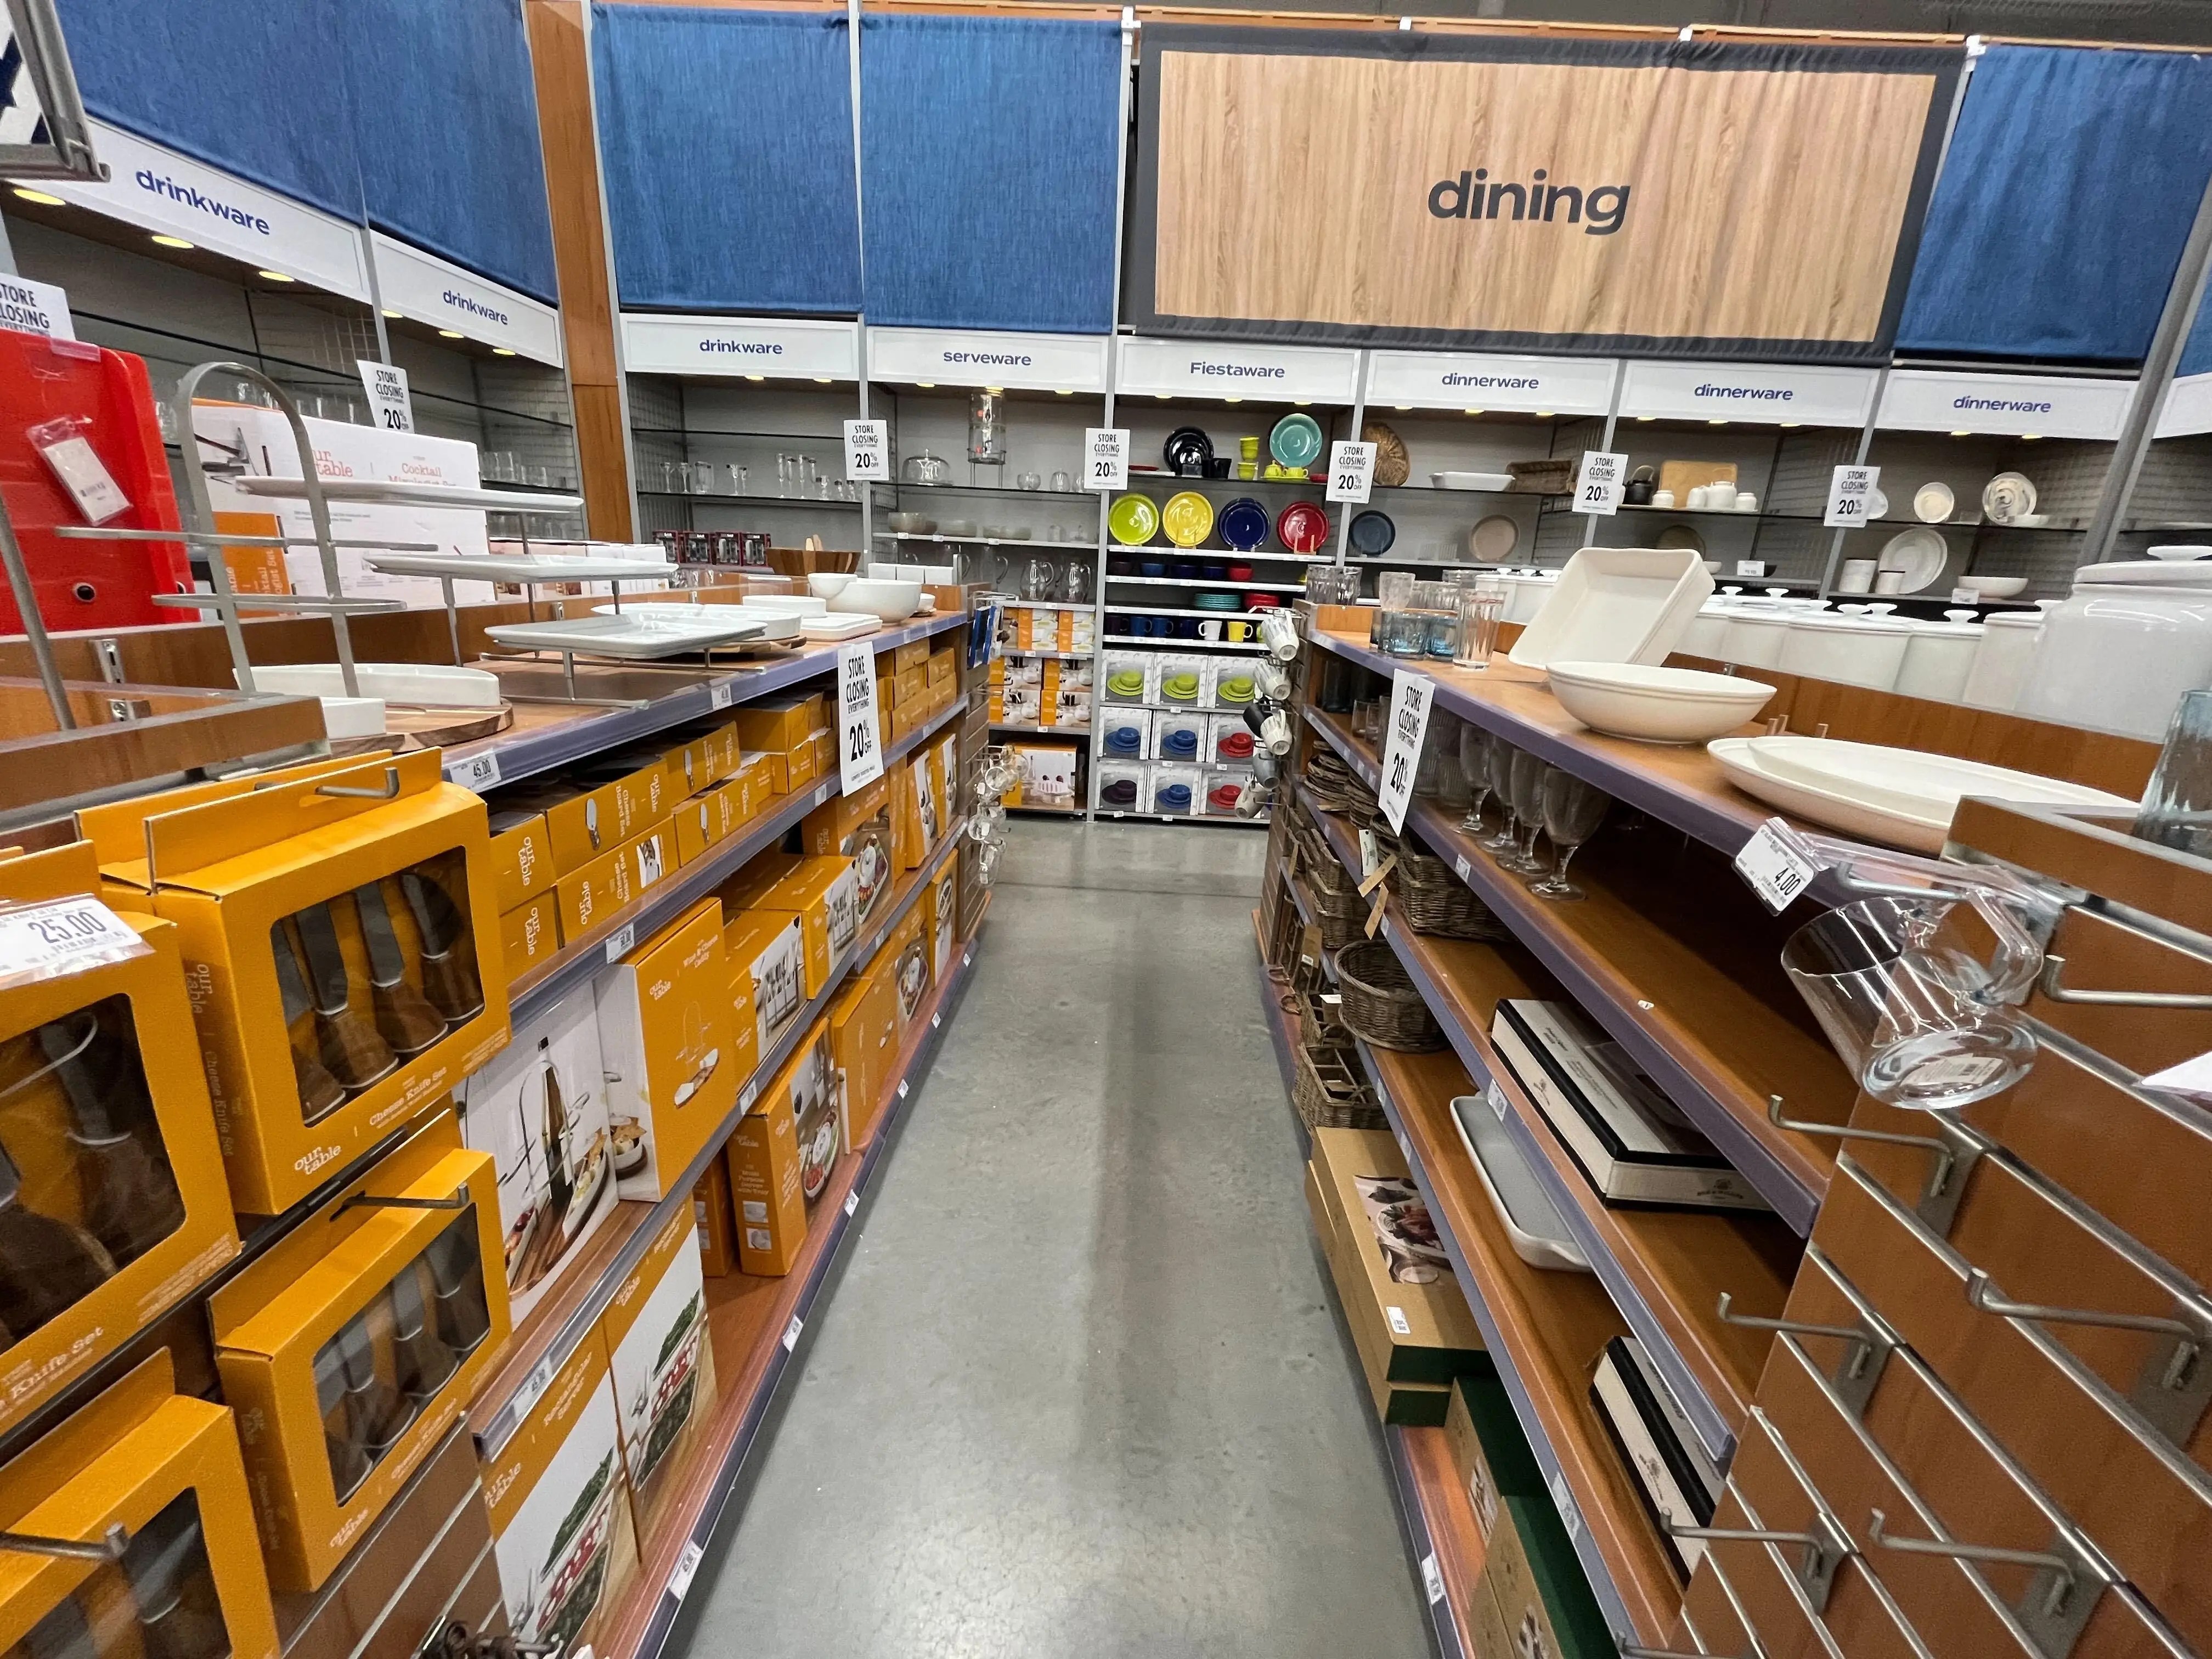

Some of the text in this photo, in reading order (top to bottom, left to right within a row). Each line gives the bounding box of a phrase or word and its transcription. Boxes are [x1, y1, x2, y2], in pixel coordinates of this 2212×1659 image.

[136, 168, 270, 235] drinkware
[1428, 168, 1630, 235] dining
[0, 283, 37, 307] TORE
[0, 302, 50, 329] LOSING
[442, 289, 509, 326] drinkware
[699, 339, 783, 357] drinkware
[943, 350, 1032, 366] serveware
[376, 370, 398, 384] STORE
[1190, 362, 1285, 379] Fiestaware
[1441, 373, 1539, 390] dinnerware
[376, 383, 404, 398] CLOSING
[1694, 383, 1793, 402] dinnerware
[1953, 394, 2051, 413] dinnerware
[852, 435, 878, 443] CLOSING
[855, 425, 873, 433] STORE
[1098, 433, 1116, 443] STORE
[313, 450, 331, 462] ur
[1094, 443, 1119, 453] CLOSING
[1344, 446, 1364, 455] STORE
[317, 460, 353, 477] table
[402, 463, 442, 477] Cocktail
[1339, 456, 1366, 466] CLOSING
[1589, 467, 1615, 477] CLOSING
[1595, 458, 1614, 467] STORE
[1841, 481, 1869, 490] CLOSING
[1847, 471, 1867, 479] STORE
[849, 656, 865, 679] STORE
[847, 678, 869, 703] CLOSING
[1405, 685, 1423, 712] STORE
[848, 698, 869, 714] EVERYTHING
[1398, 708, 1420, 738] CLOSING
[616, 785, 624, 817] Board
[524, 836, 535, 864] our
[518, 847, 532, 886] table
[614, 862, 623, 899] Cheese
[622, 871, 630, 903] Board
[1774, 867, 1801, 896] 4.00
[582, 881, 592, 915] table
[531, 907, 540, 933] our
[579, 901, 588, 925] our
[27, 911, 107, 944] 25.00
[524, 918, 537, 956] table
[198, 964, 213, 995] our
[185, 972, 207, 1014] table
[369, 1097, 405, 1126] Cheese
[406, 1077, 431, 1101] Knife
[431, 1066, 448, 1082] Set
[214, 1099, 229, 1133] Knife
[221, 1136, 234, 1157] Set
[294, 1146, 322, 1171] our
[304, 1143, 342, 1175] table
[10, 1354, 67, 1400] Knife
[71, 1327, 104, 1355] Set
